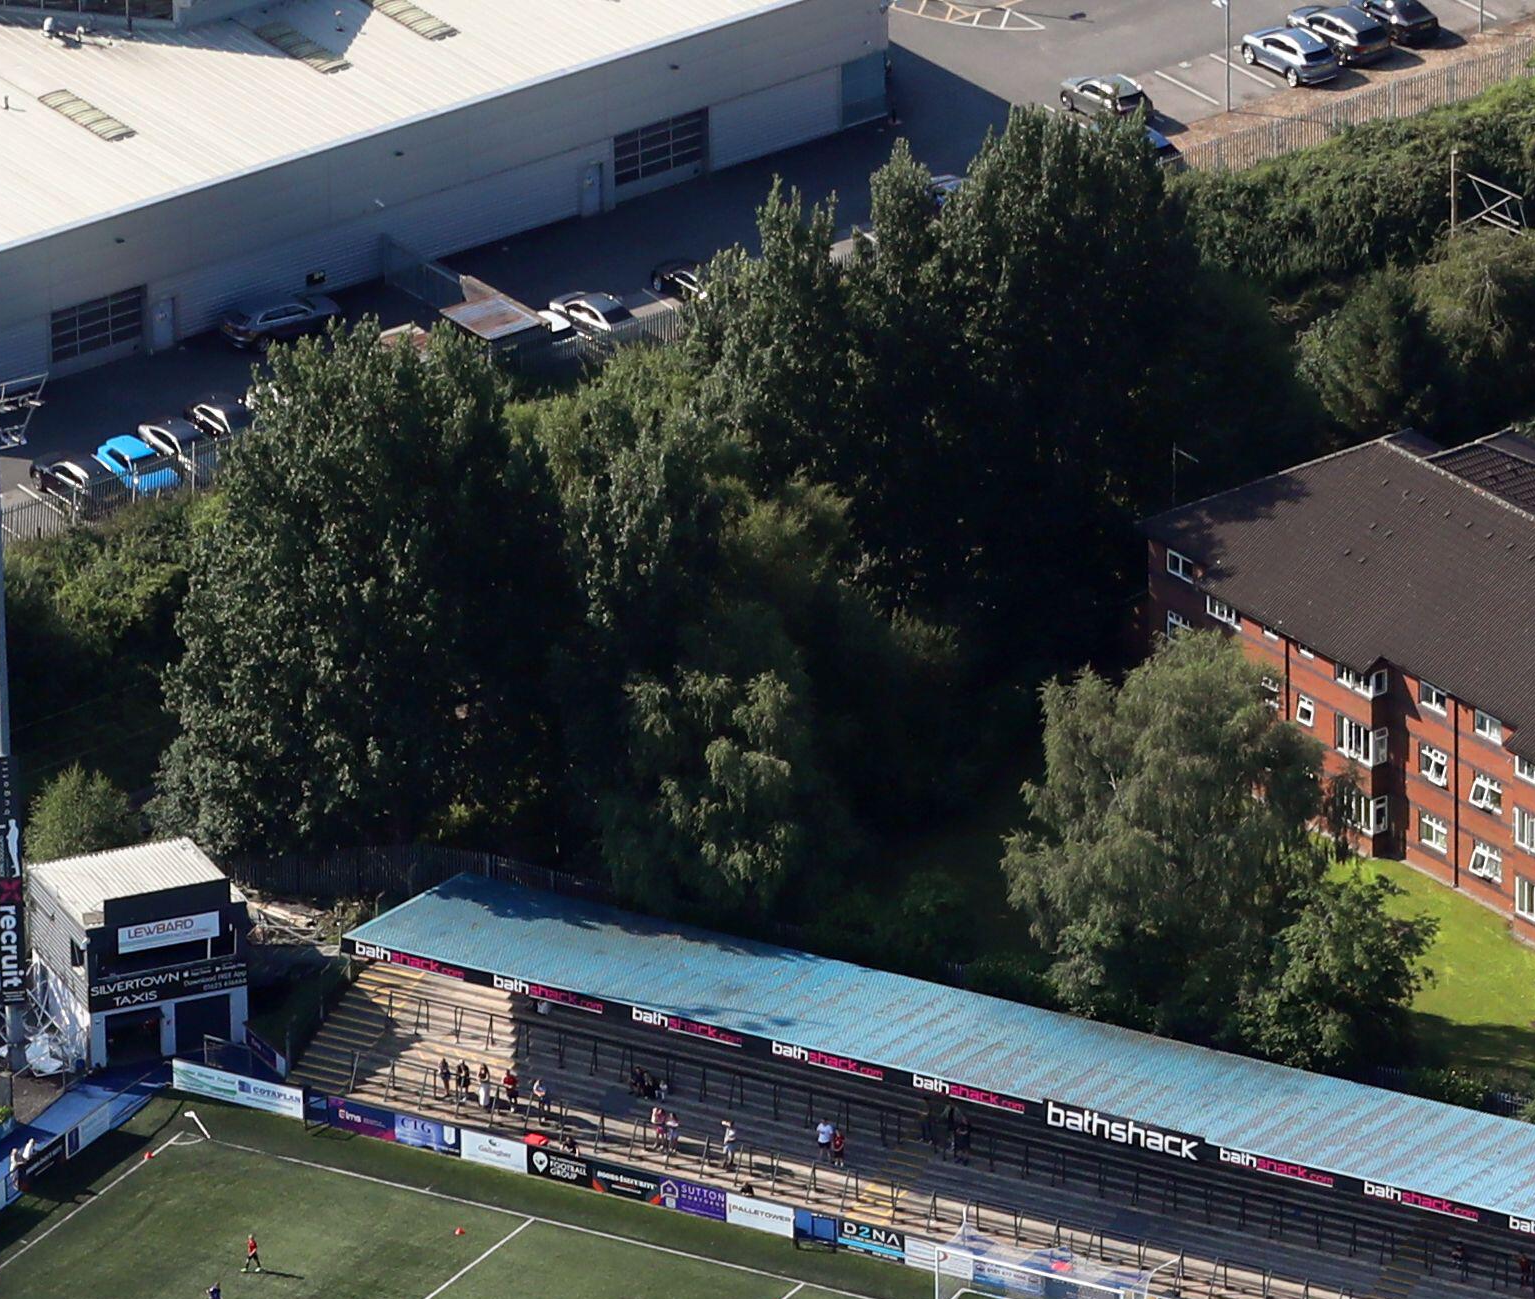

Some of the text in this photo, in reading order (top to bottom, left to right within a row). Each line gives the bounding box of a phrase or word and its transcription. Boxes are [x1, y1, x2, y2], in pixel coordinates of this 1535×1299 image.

[0, 905, 25, 988] recruit
[128, 918, 194, 939] LEWBARD
[355, 941, 465, 979] bathshack.com
[90, 972, 179, 997] SILVERTOWN
[113, 991, 157, 1006] TAXIS
[493, 975, 604, 1011] bathshack.com
[632, 1006, 743, 1044] bathshack.com
[772, 1041, 883, 1078] bathshack.com
[253, 1086, 301, 1103] COTAPLAN
[913, 1074, 1025, 1112] bathshack.com
[1047, 1101, 1199, 1160] bathshack
[549, 1161, 587, 1177] FOOTBALL
[550, 1168, 578, 1181] GROUP
[1219, 1147, 1334, 1185] bathshack.com
[681, 1184, 725, 1202] SUTTON
[1364, 1181, 1479, 1220] bathshack.com
[731, 1205, 792, 1223] PALLETOWER
